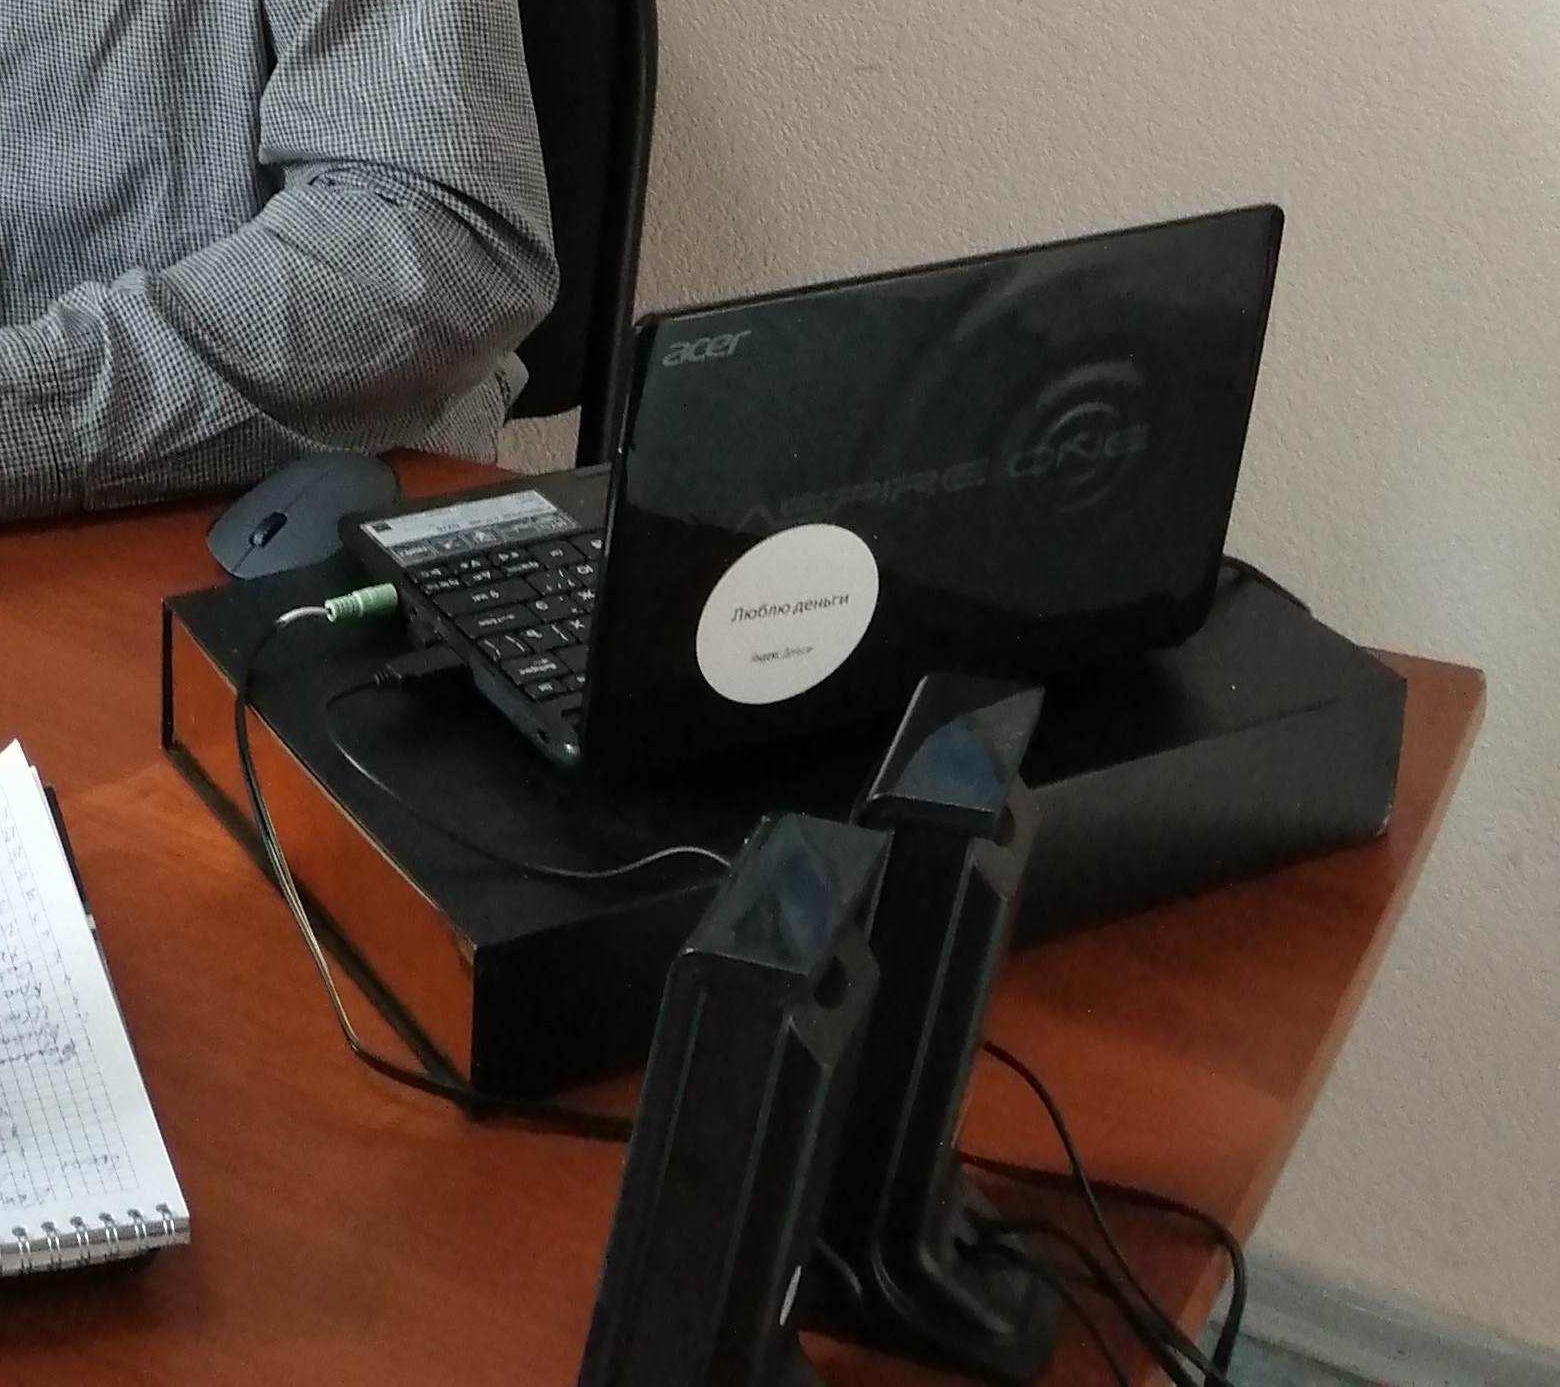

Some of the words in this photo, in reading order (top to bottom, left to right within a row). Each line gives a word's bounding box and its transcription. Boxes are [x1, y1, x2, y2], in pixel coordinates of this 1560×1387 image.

[662, 329, 752, 367] acer
[731, 602, 790, 623] Люблю
[792, 594, 849, 616] деньги
